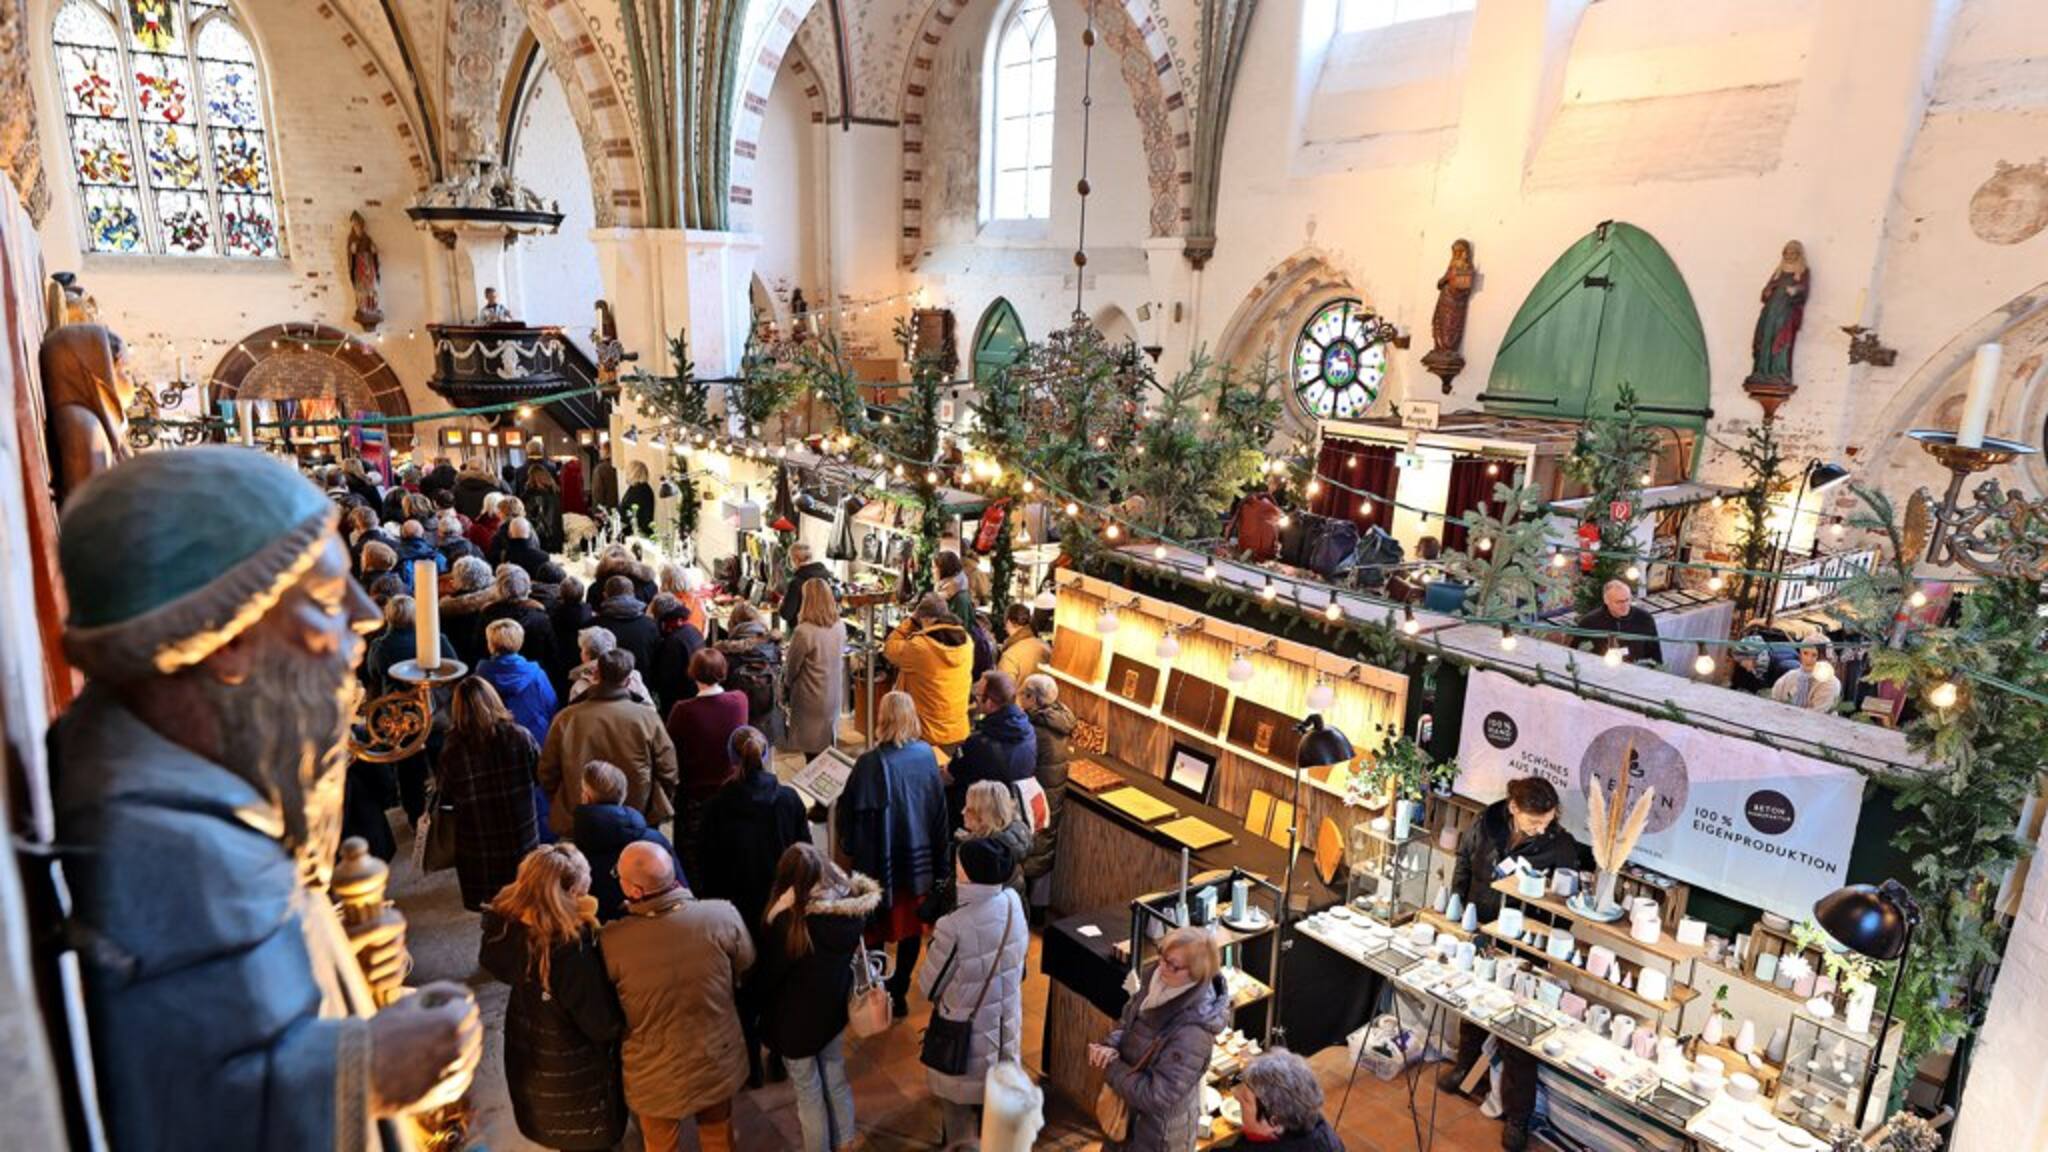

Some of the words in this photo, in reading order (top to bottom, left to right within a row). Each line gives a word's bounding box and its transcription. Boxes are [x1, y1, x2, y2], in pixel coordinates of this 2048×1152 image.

[1509, 760, 1529, 773] AUS
[1532, 767, 1568, 788] BETON
[1521, 751, 1569, 777] SCHÖNES
[1694, 807, 1718, 822] 100
[1720, 815, 1733, 827] %
[1753, 803, 1786, 816] BETON
[1692, 819, 1838, 874] EIGENPRODUKTION
